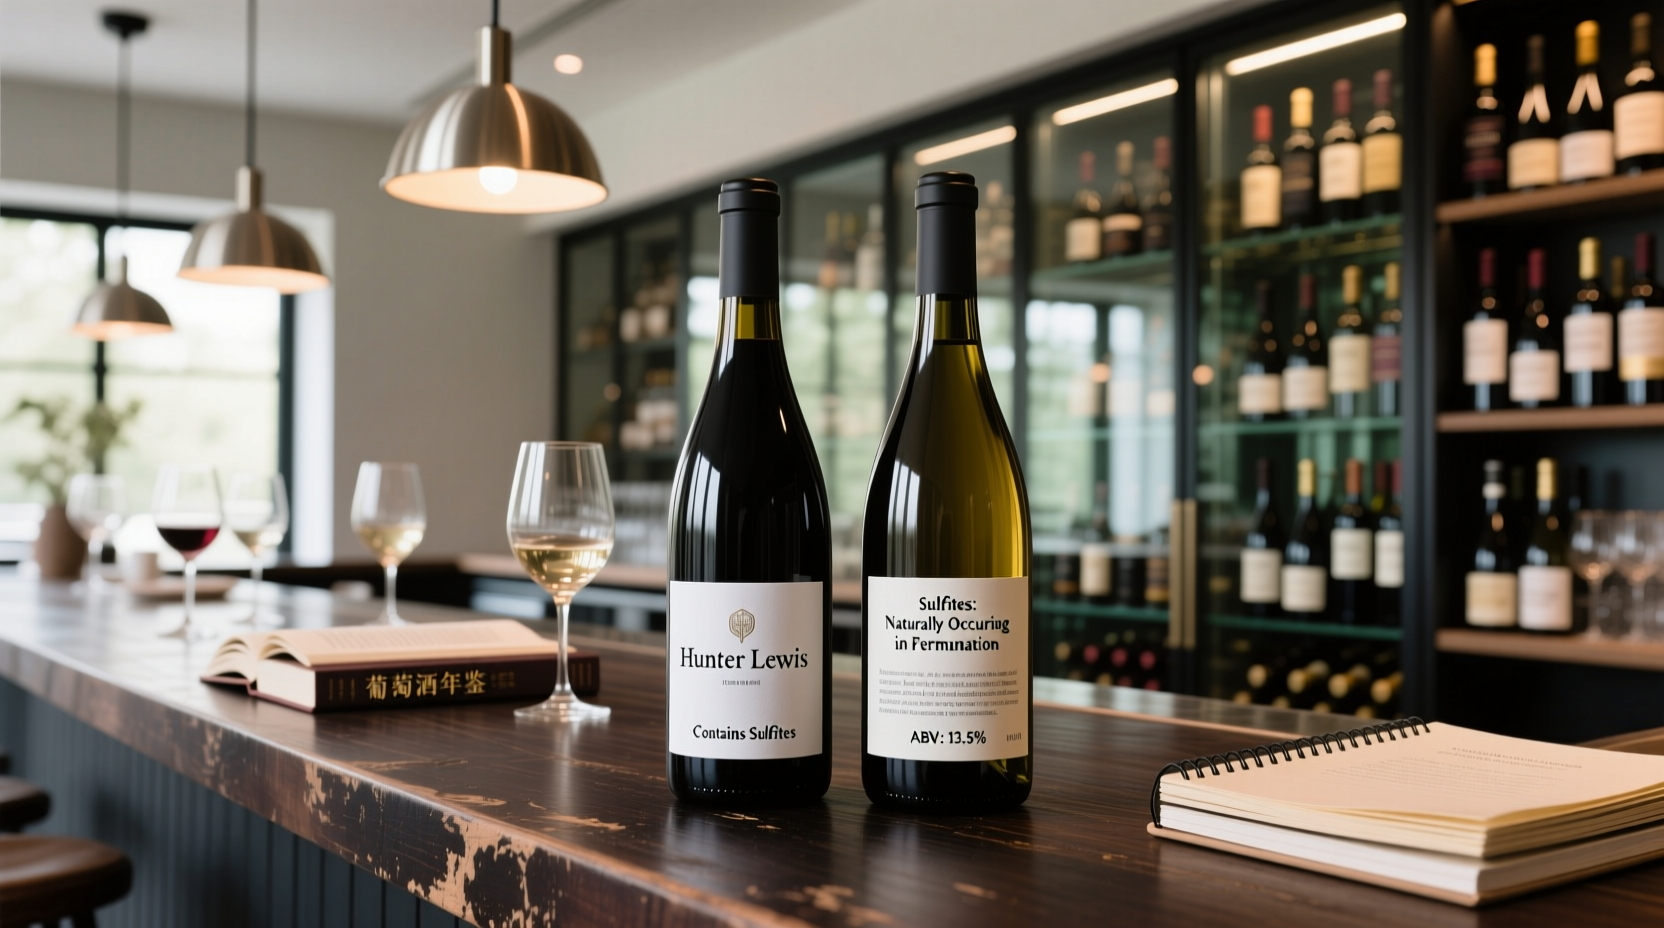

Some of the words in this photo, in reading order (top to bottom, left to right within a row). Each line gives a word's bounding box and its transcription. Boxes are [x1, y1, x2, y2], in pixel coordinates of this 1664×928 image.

[919, 595, 976, 611] Sulfites:
[885, 615, 943, 634] Naturally
[895, 635, 907, 650] in
[680, 646, 745, 669] Hunter
[751, 647, 808, 669] Lewis
[366, 669, 486, 700] 葡萄酒年鉴
[693, 725, 746, 740] Contains
[749, 725, 796, 740] Sulfites
[910, 730, 944, 744] ABV:
[948, 730, 986, 745] 13.5%
